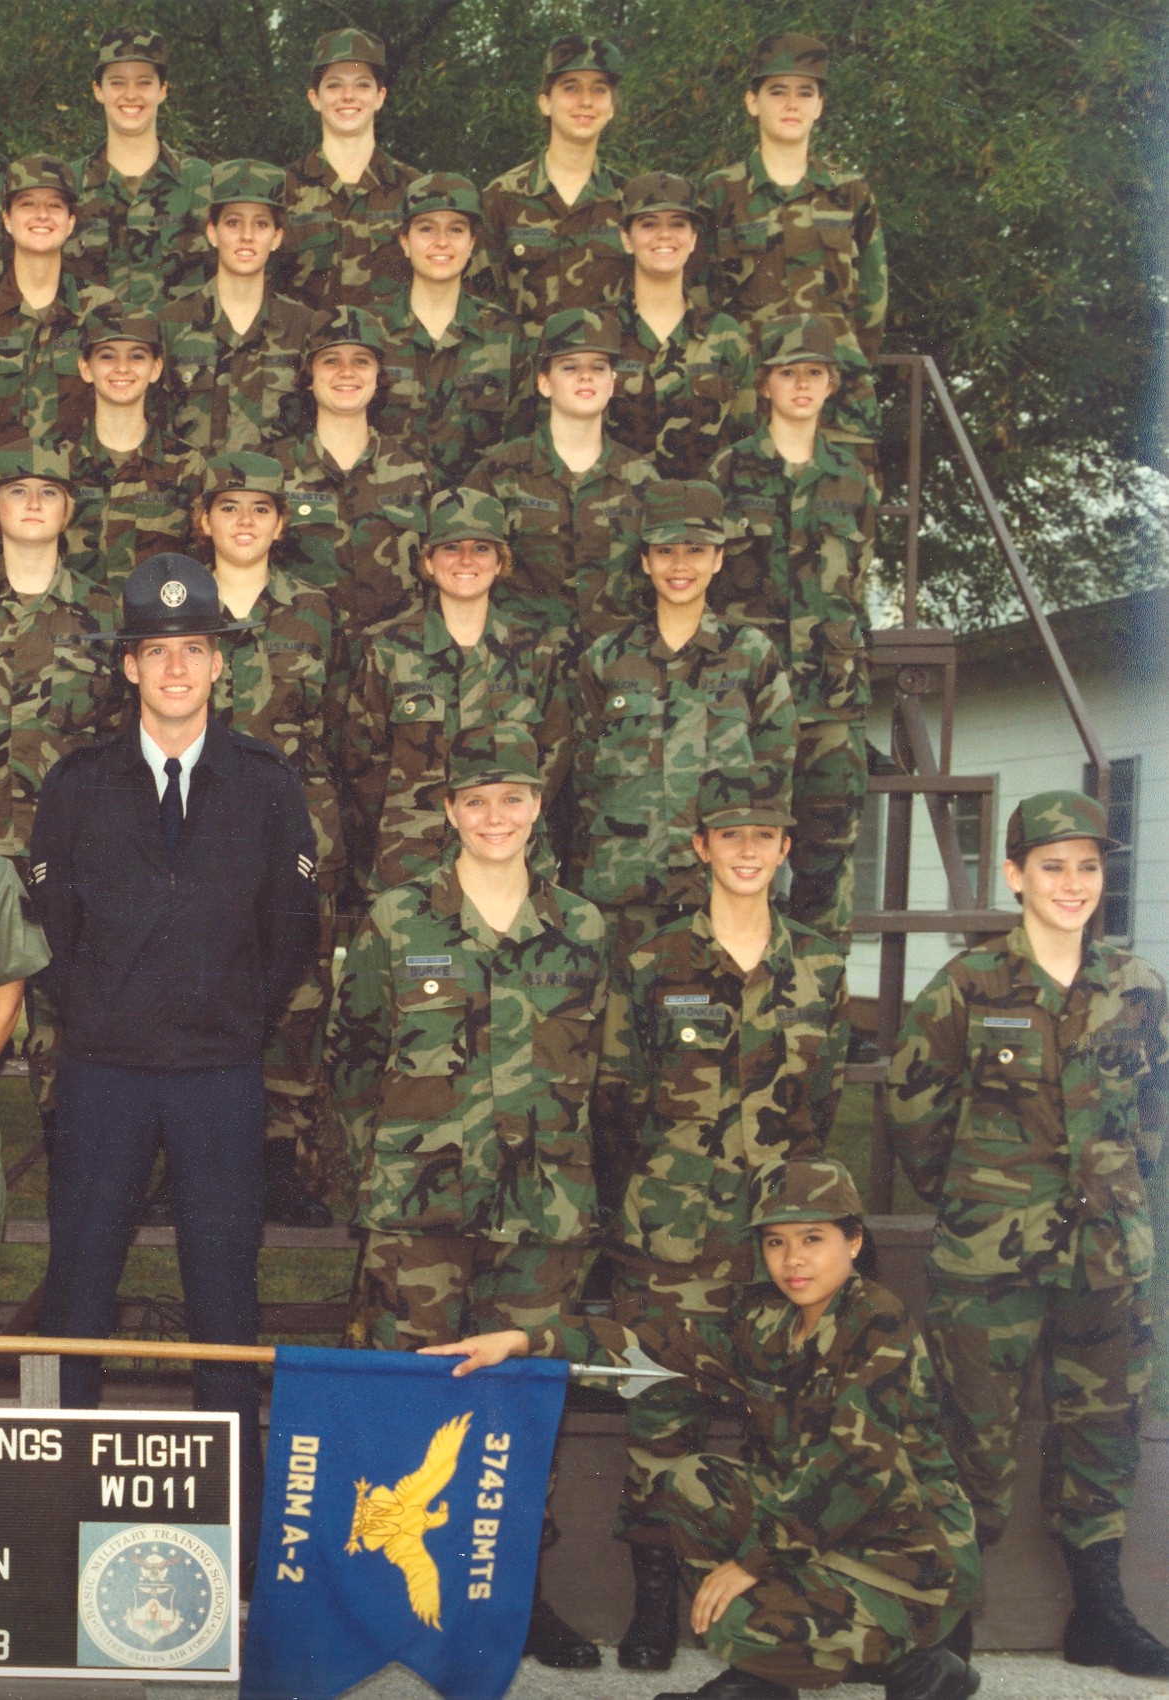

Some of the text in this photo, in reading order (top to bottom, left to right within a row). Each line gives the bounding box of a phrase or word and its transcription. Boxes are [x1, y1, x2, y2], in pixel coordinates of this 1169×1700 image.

[93, 1434, 213, 1467] FLIGHT
[277, 1434, 320, 1583] DORM A-2
[468, 1432, 511, 1601] 3743 BMTS
[90, 1530, 149, 1571] MILITARY
[152, 1529, 216, 1567] TRAINING
[211, 1568, 226, 1621] SCHOOL
[168, 1649, 188, 1662] AIR
